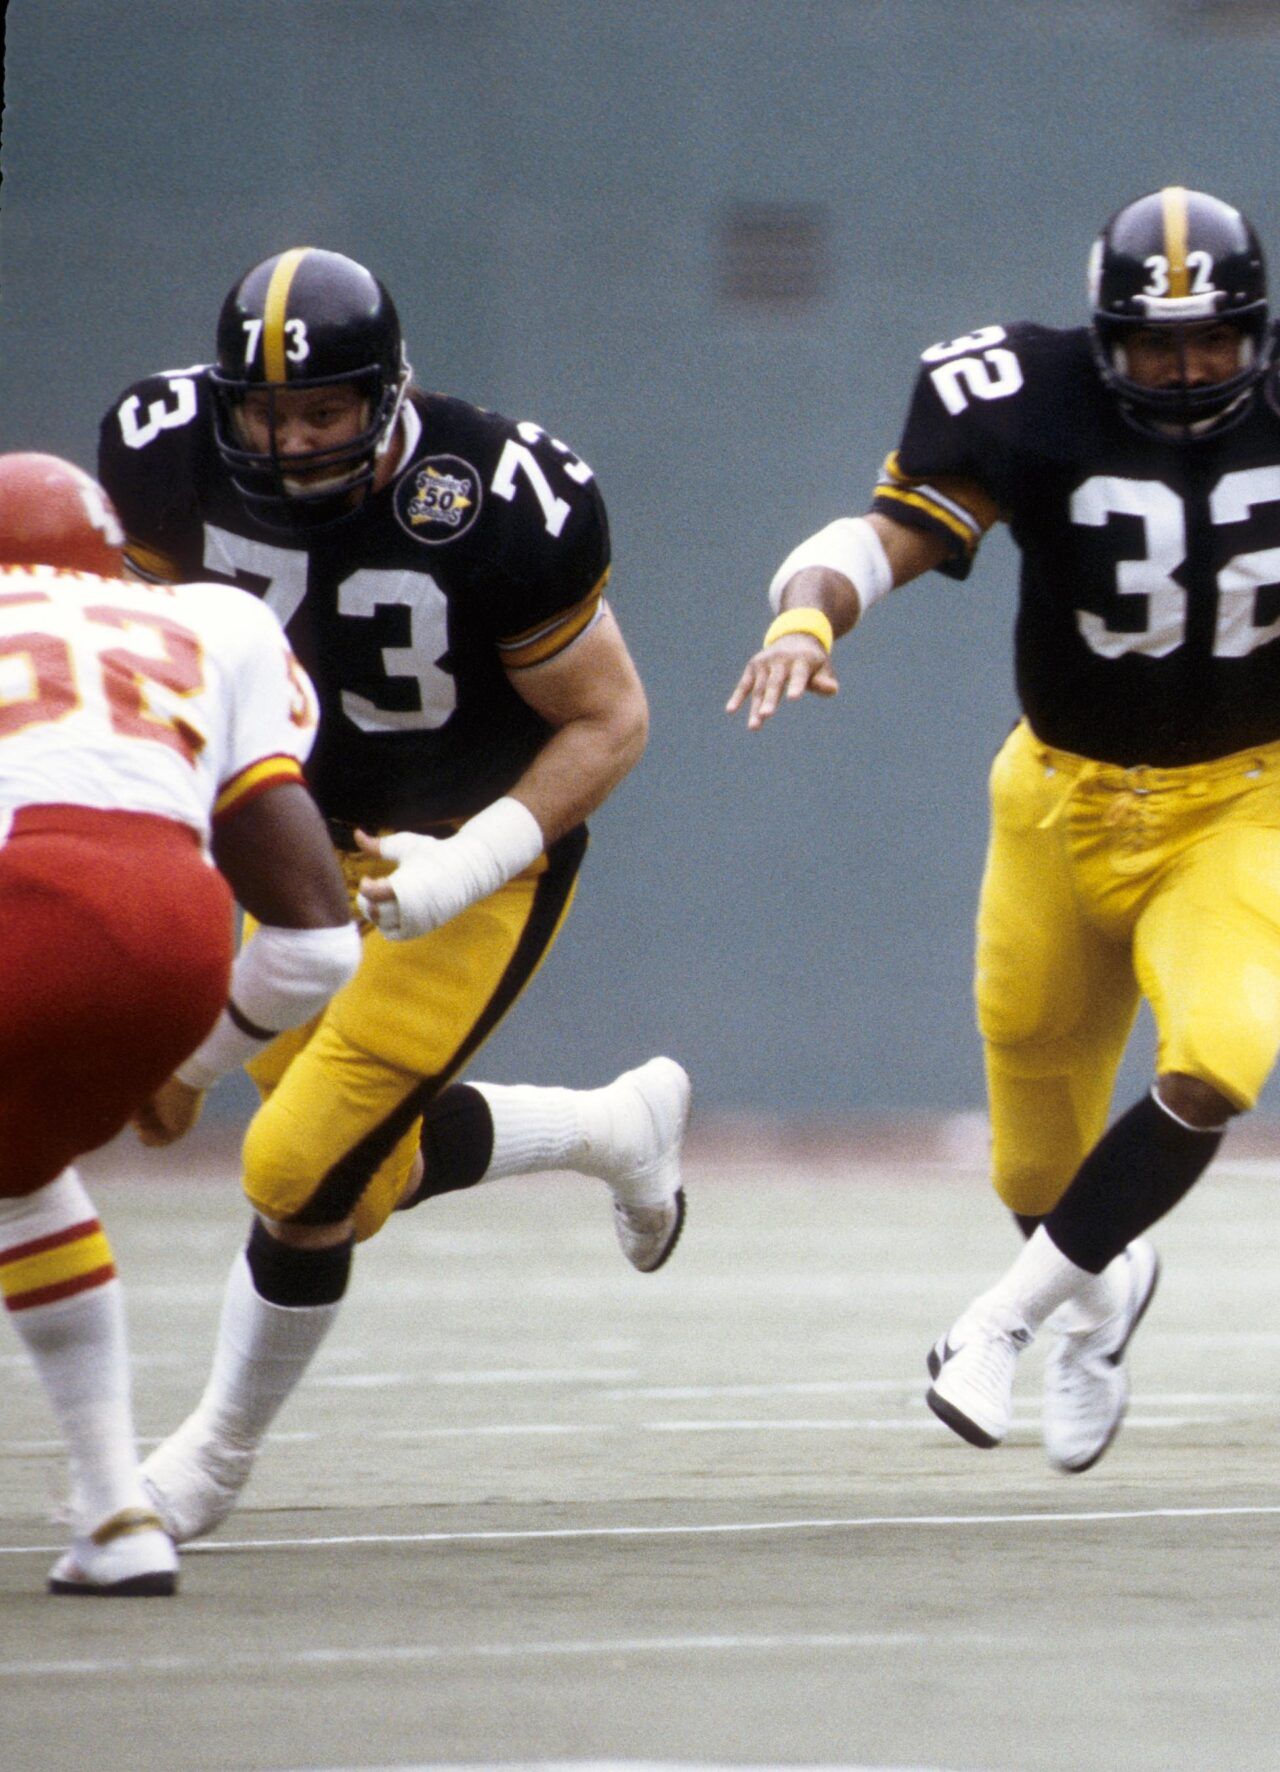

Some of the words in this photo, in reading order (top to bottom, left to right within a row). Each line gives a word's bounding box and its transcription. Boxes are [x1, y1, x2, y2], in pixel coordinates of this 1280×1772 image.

[1143, 250, 1216, 297] 32
[242, 319, 310, 365] 73
[118, 365, 205, 450] 3
[423, 486, 456, 511] 50
[203, 521, 457, 733] 73
